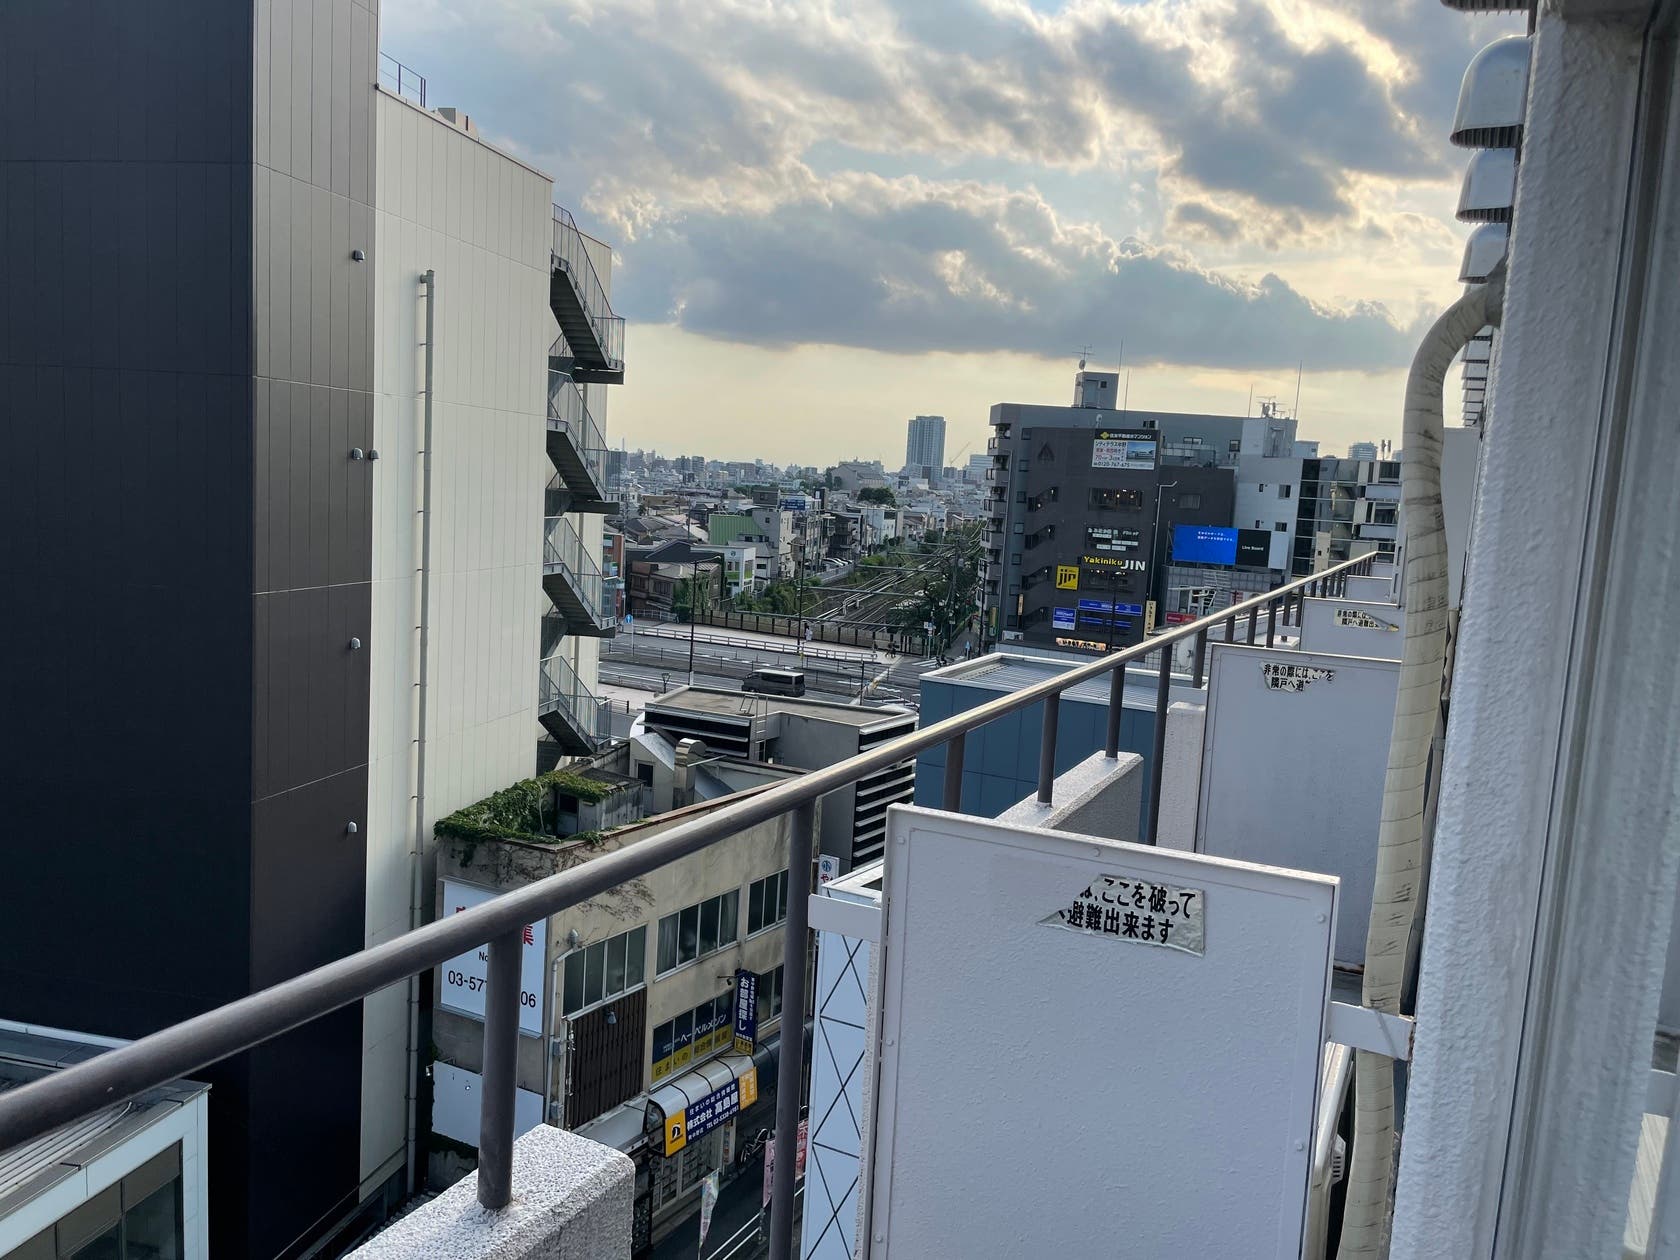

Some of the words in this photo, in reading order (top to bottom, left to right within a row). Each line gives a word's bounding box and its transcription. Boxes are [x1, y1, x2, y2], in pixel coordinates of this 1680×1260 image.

[1084, 556, 1123, 566] Yakiniku
[1120, 559, 1146, 571] JIN
[1271, 677, 1312, 692] 隣戸へ避
[738, 977, 749, 1030] お部屋探し
[687, 1108, 713, 1131] 株式会社
